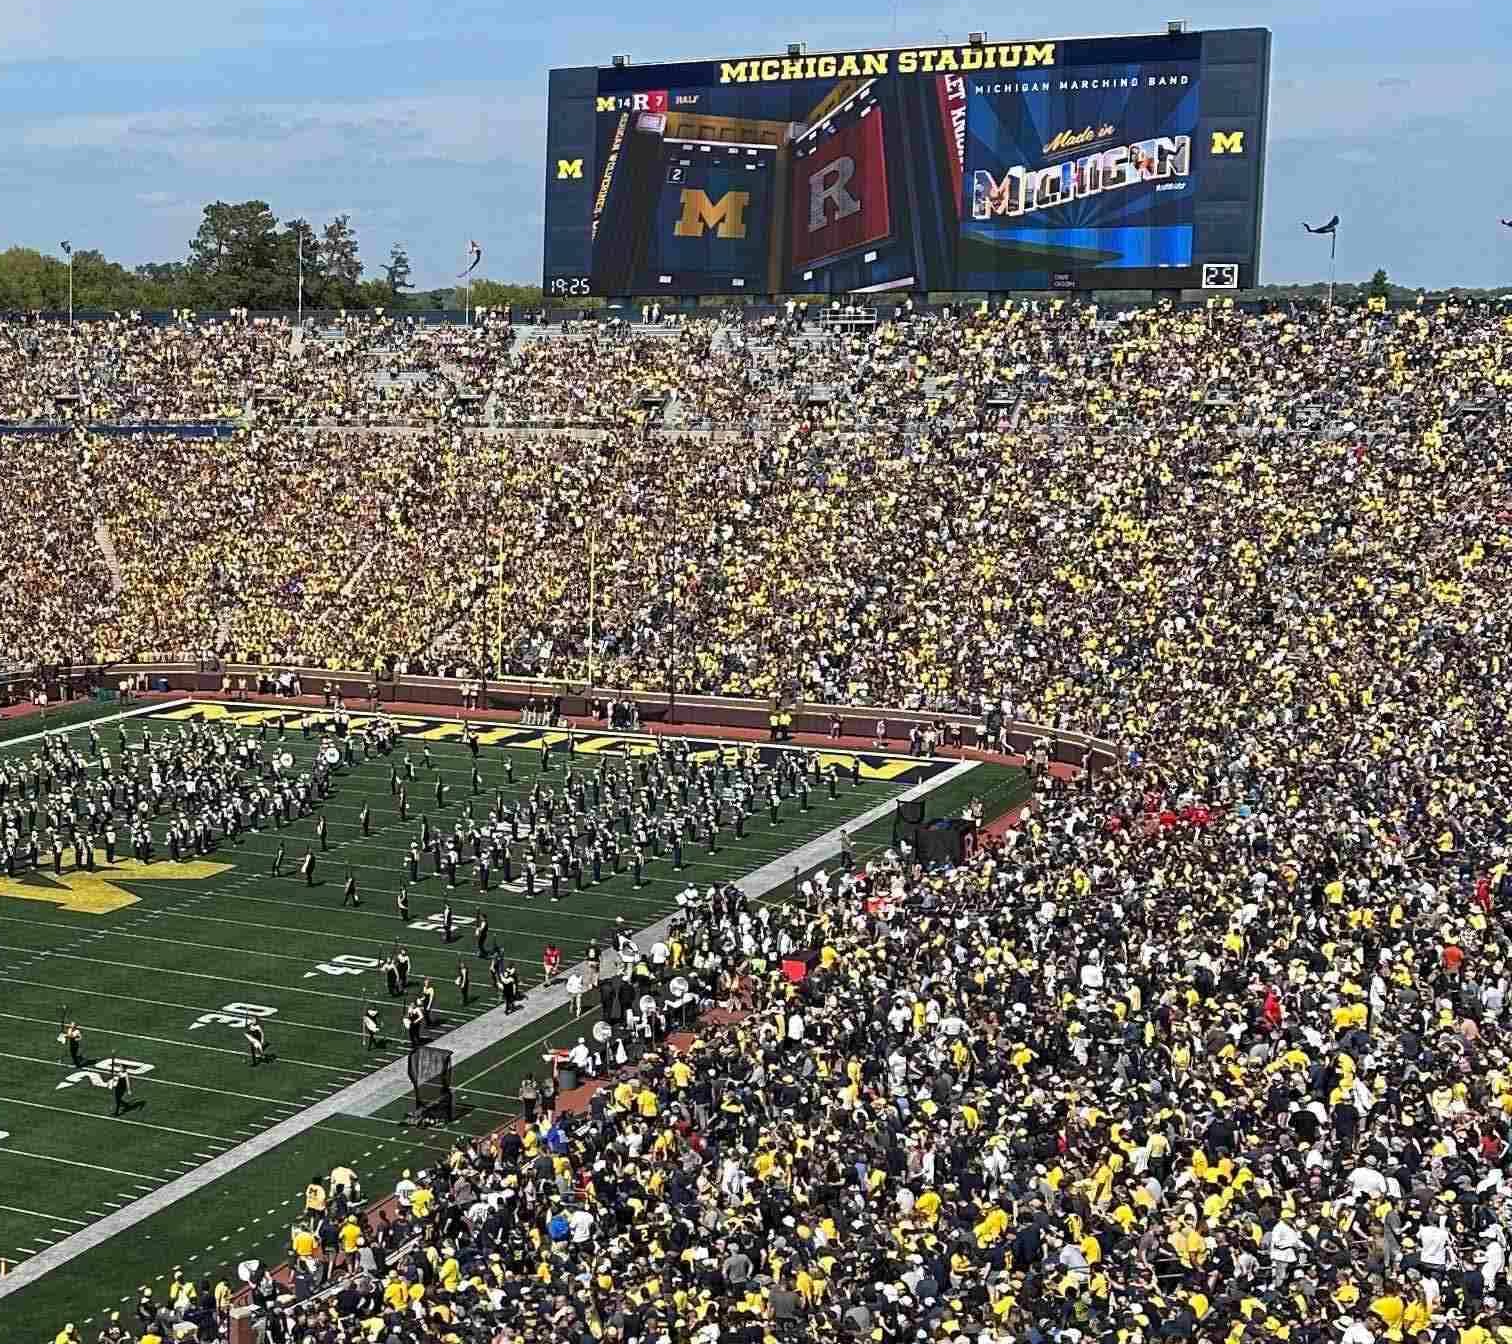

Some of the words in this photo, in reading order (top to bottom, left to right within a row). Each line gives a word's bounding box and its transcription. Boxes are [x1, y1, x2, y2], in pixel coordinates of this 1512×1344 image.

[720, 54, 888, 83] MICHIGAN
[898, 43, 1055, 74] STADIUM
[975, 82, 1050, 95] MICHIGAN
[1059, 77, 1139, 91] MARCHING
[1148, 74, 1189, 87] BAND
[596, 96, 616, 112] M
[617, 97, 631, 109] 14
[633, 93, 649, 111] R
[655, 95, 664, 107] 7
[1043, 127, 1094, 152] Made
[1211, 131, 1245, 154] M
[556, 159, 584, 180] M
[972, 135, 1191, 220] MICHIGAN
[808, 155, 862, 233] R
[673, 189, 750, 238] M
[551, 277, 591, 295] 19:25
[1205, 267, 1234, 286] 25
[197, 1002, 279, 1028] 30
[66, 1058, 155, 1090] 20
